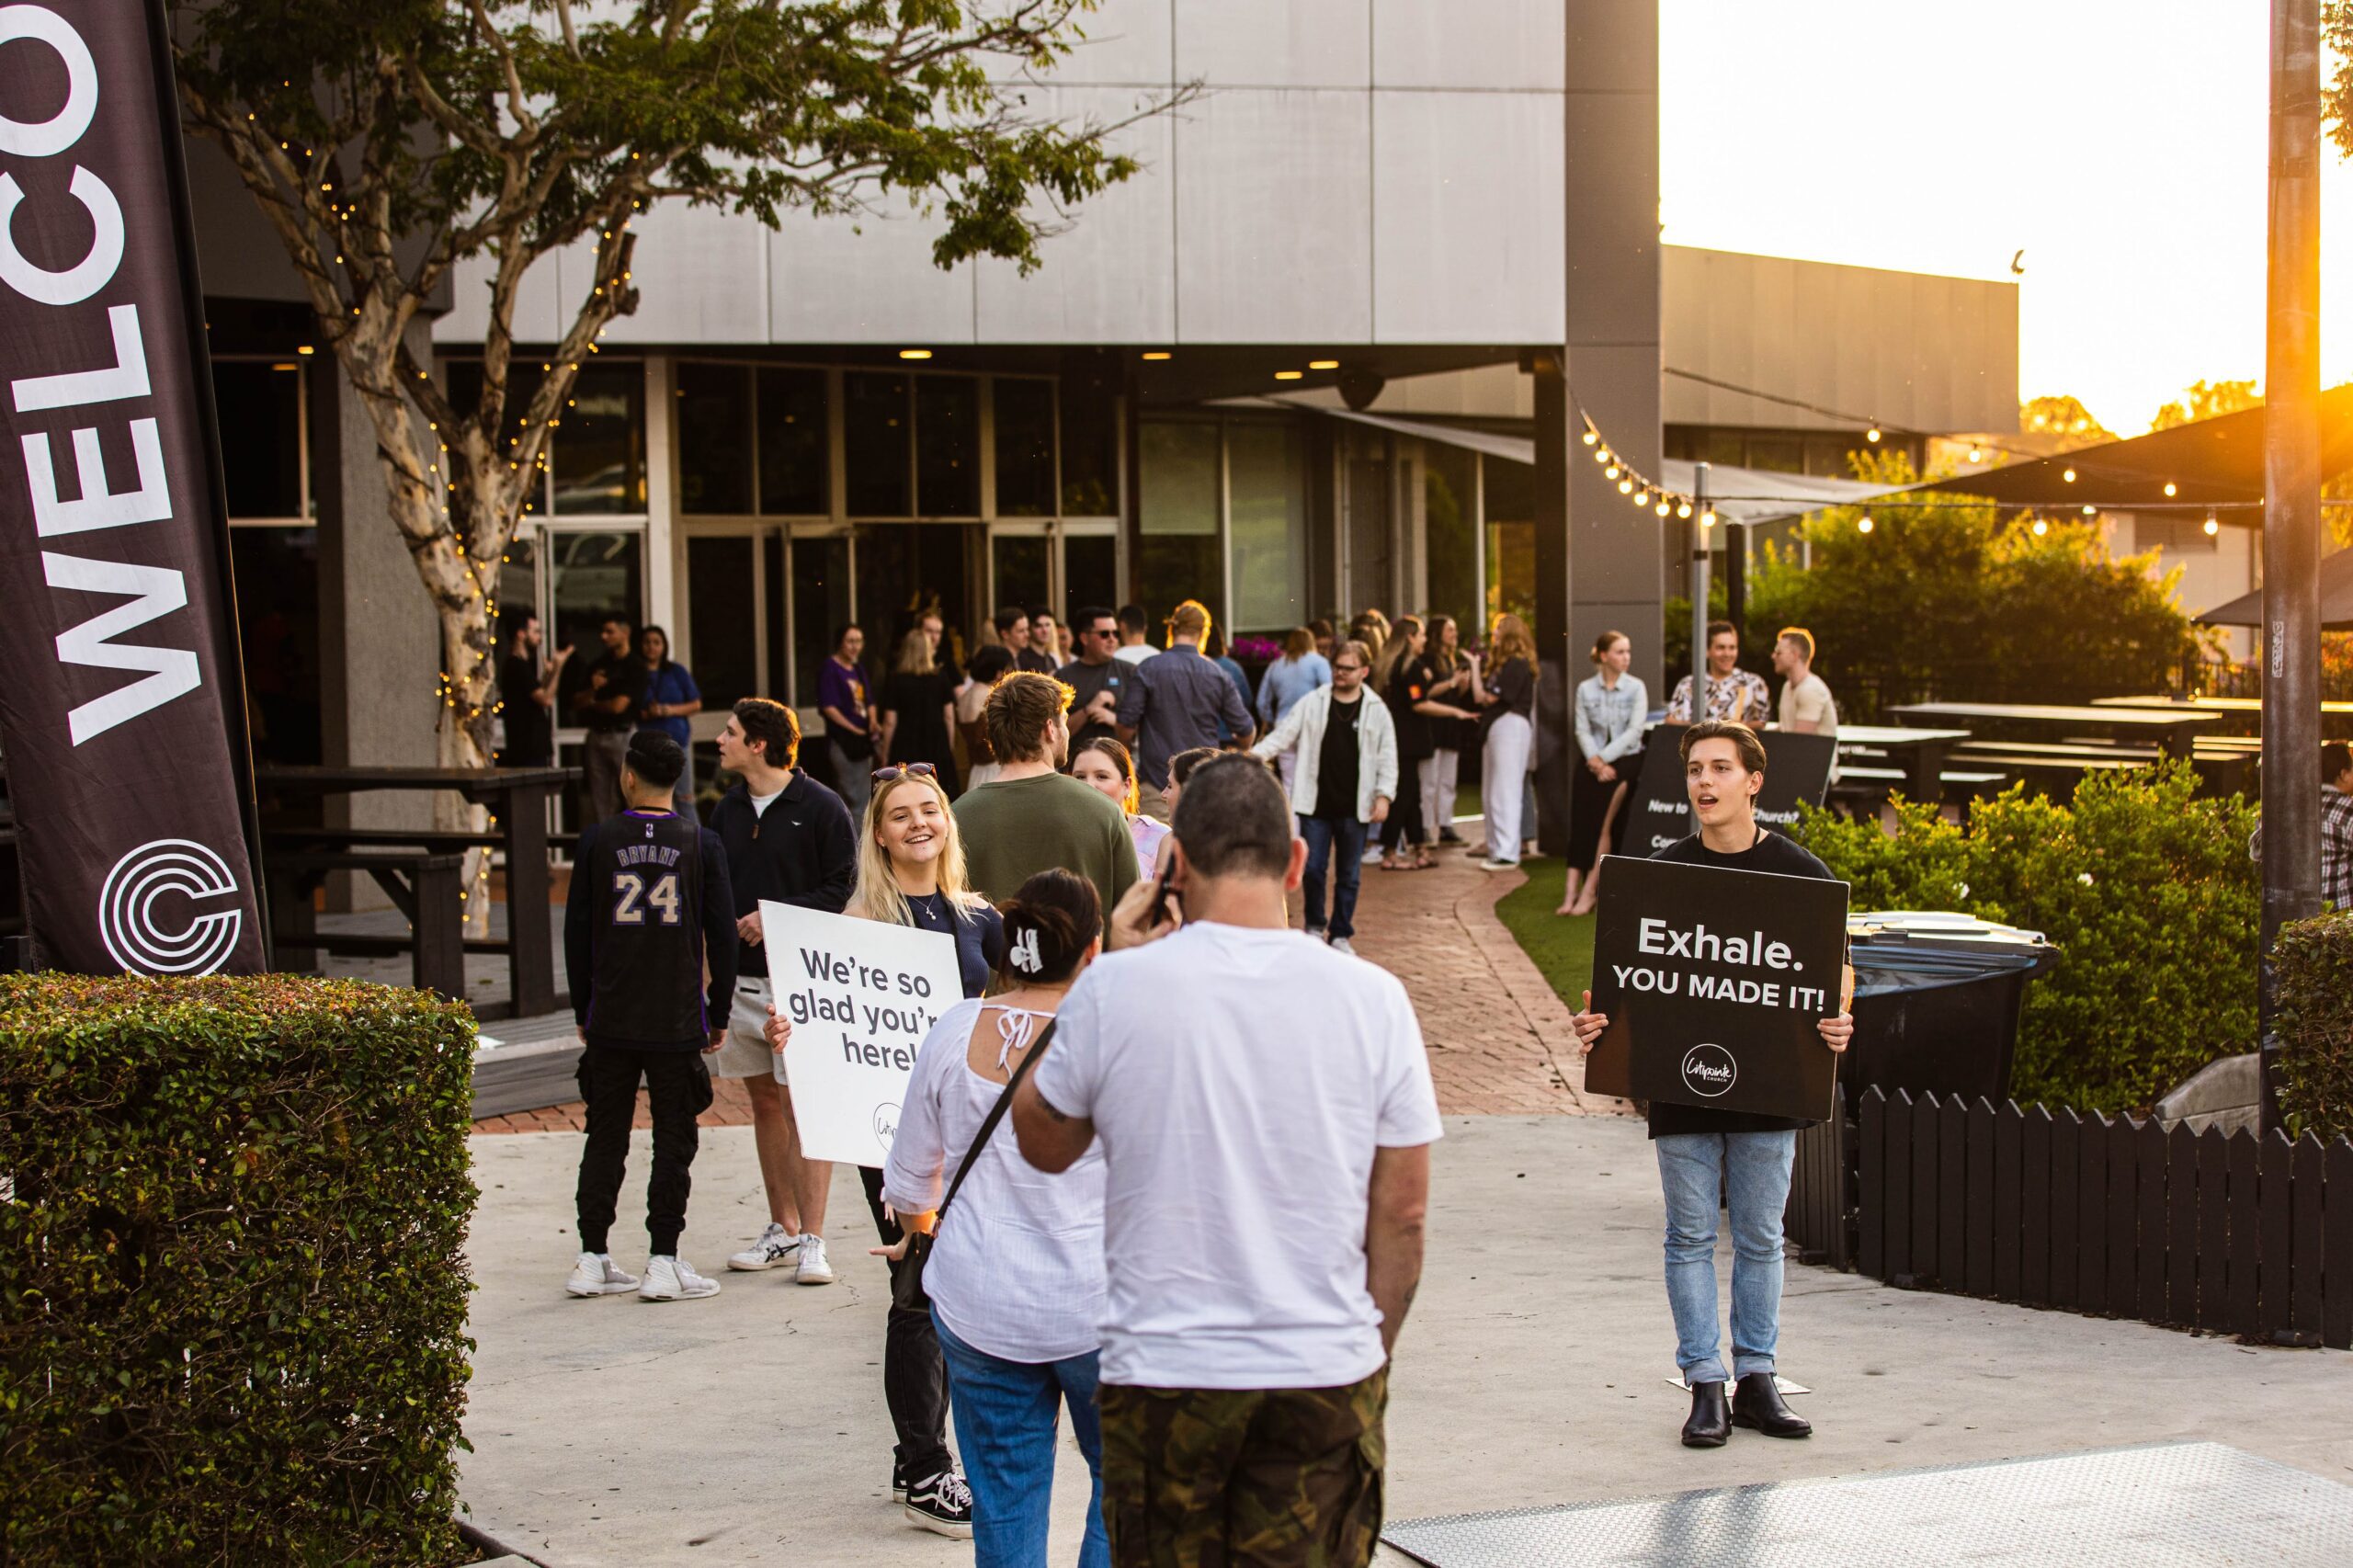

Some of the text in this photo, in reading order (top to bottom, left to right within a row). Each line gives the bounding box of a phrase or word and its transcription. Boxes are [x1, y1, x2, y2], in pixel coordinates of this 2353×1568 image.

[1647, 799, 1674, 813] New
[1675, 801, 1688, 815] to
[617, 845, 680, 867] BRYANT
[613, 871, 681, 926] 24
[1638, 917, 1803, 971] Exhale.
[800, 948, 931, 997] We're so
[1612, 965, 1824, 1012] YOU MADE IT!
[789, 988, 937, 1035] glad you'r
[1687, 1057, 1732, 1080] Citipointe
